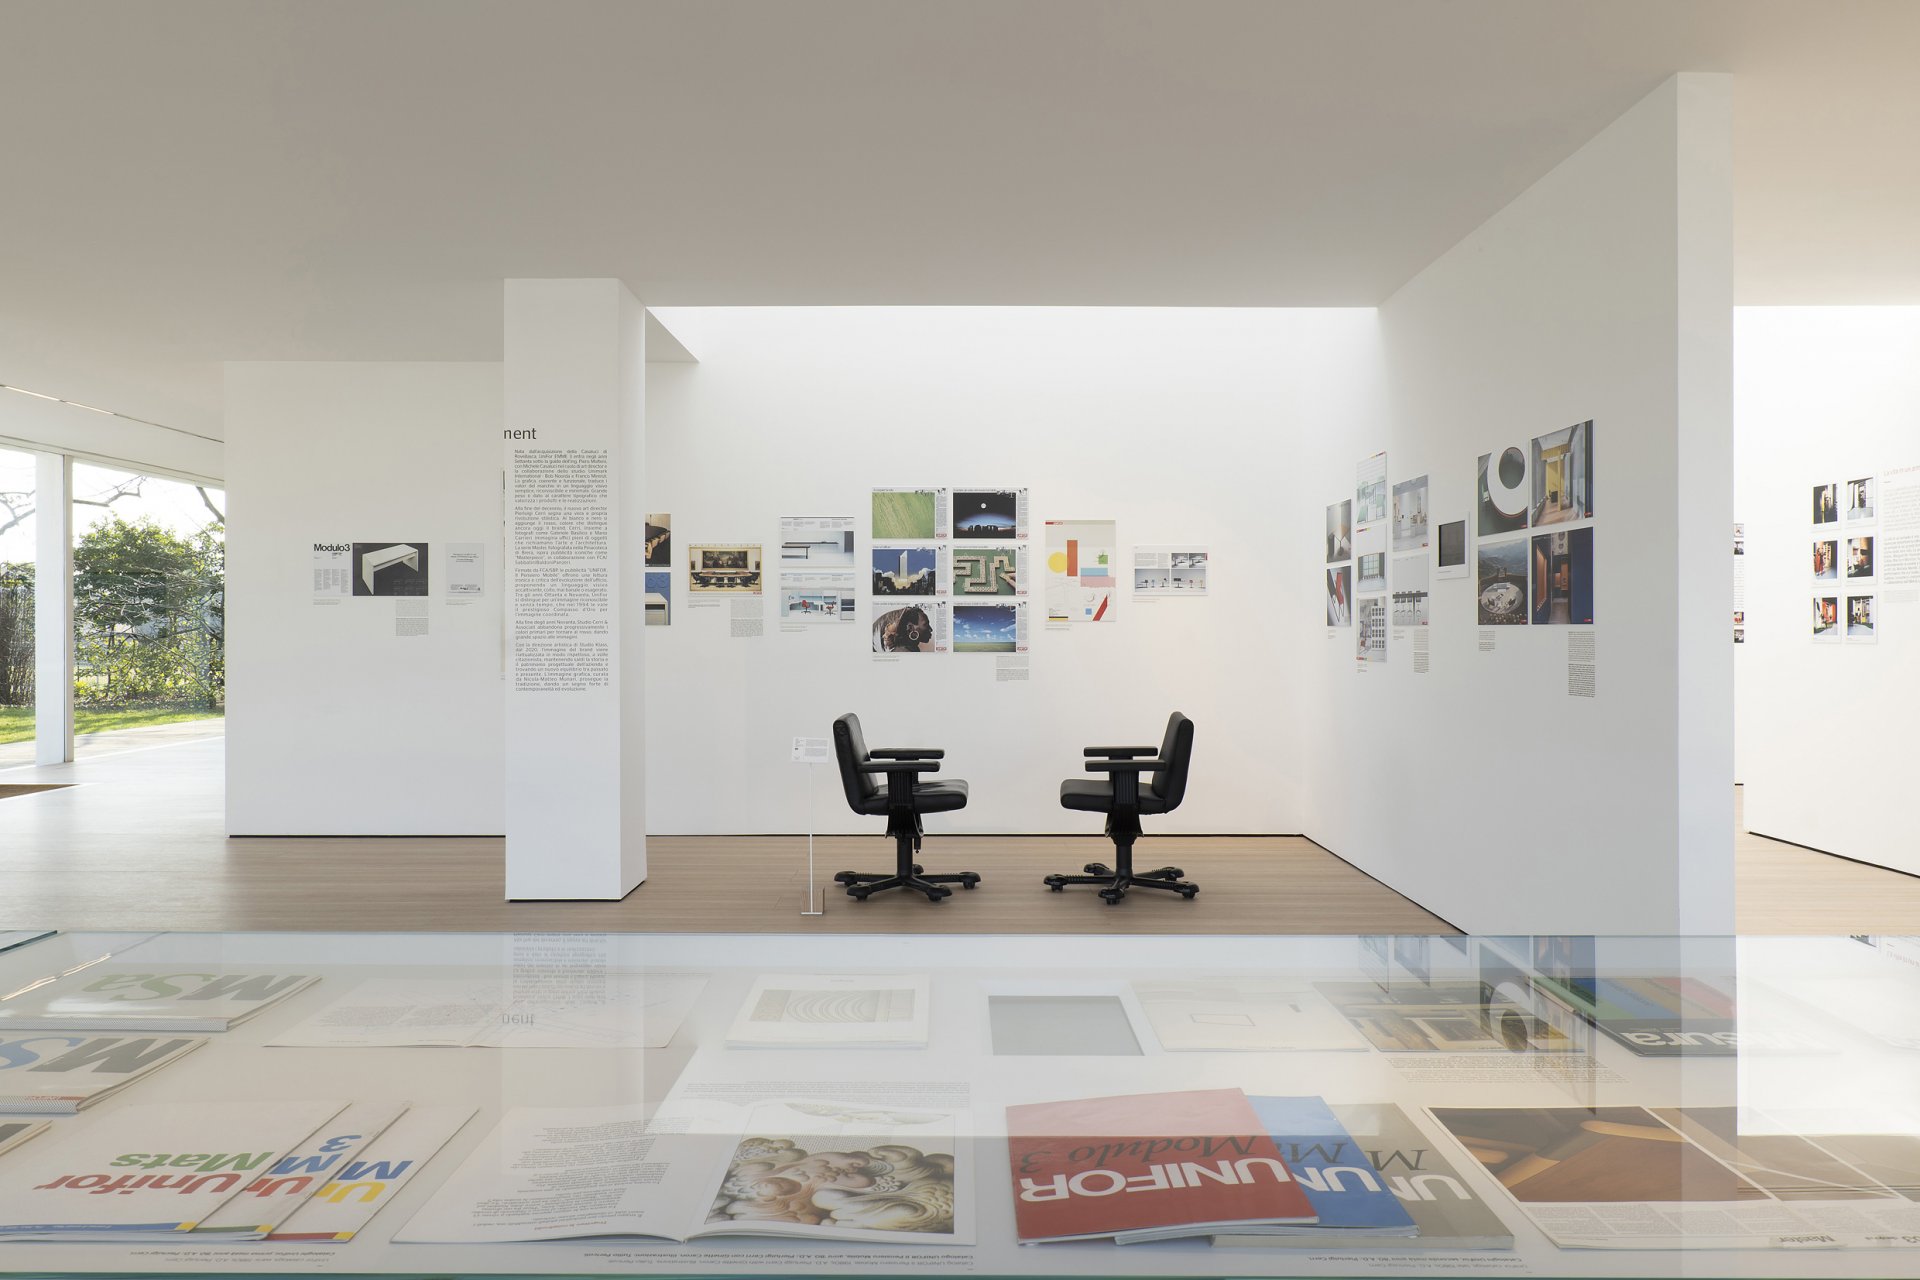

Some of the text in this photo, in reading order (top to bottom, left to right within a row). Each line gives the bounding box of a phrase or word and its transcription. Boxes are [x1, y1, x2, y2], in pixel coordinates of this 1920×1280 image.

[1620, 1031, 1743, 1047] sura
[0, 1037, 194, 1074] MS
[318, 1135, 362, 1152] 3
[110, 1152, 275, 1172] Mats
[1020, 1135, 1256, 1174] Modulo 3
[33, 1173, 242, 1194] Unifor
[1020, 1158, 1291, 1202] UNIFOR
